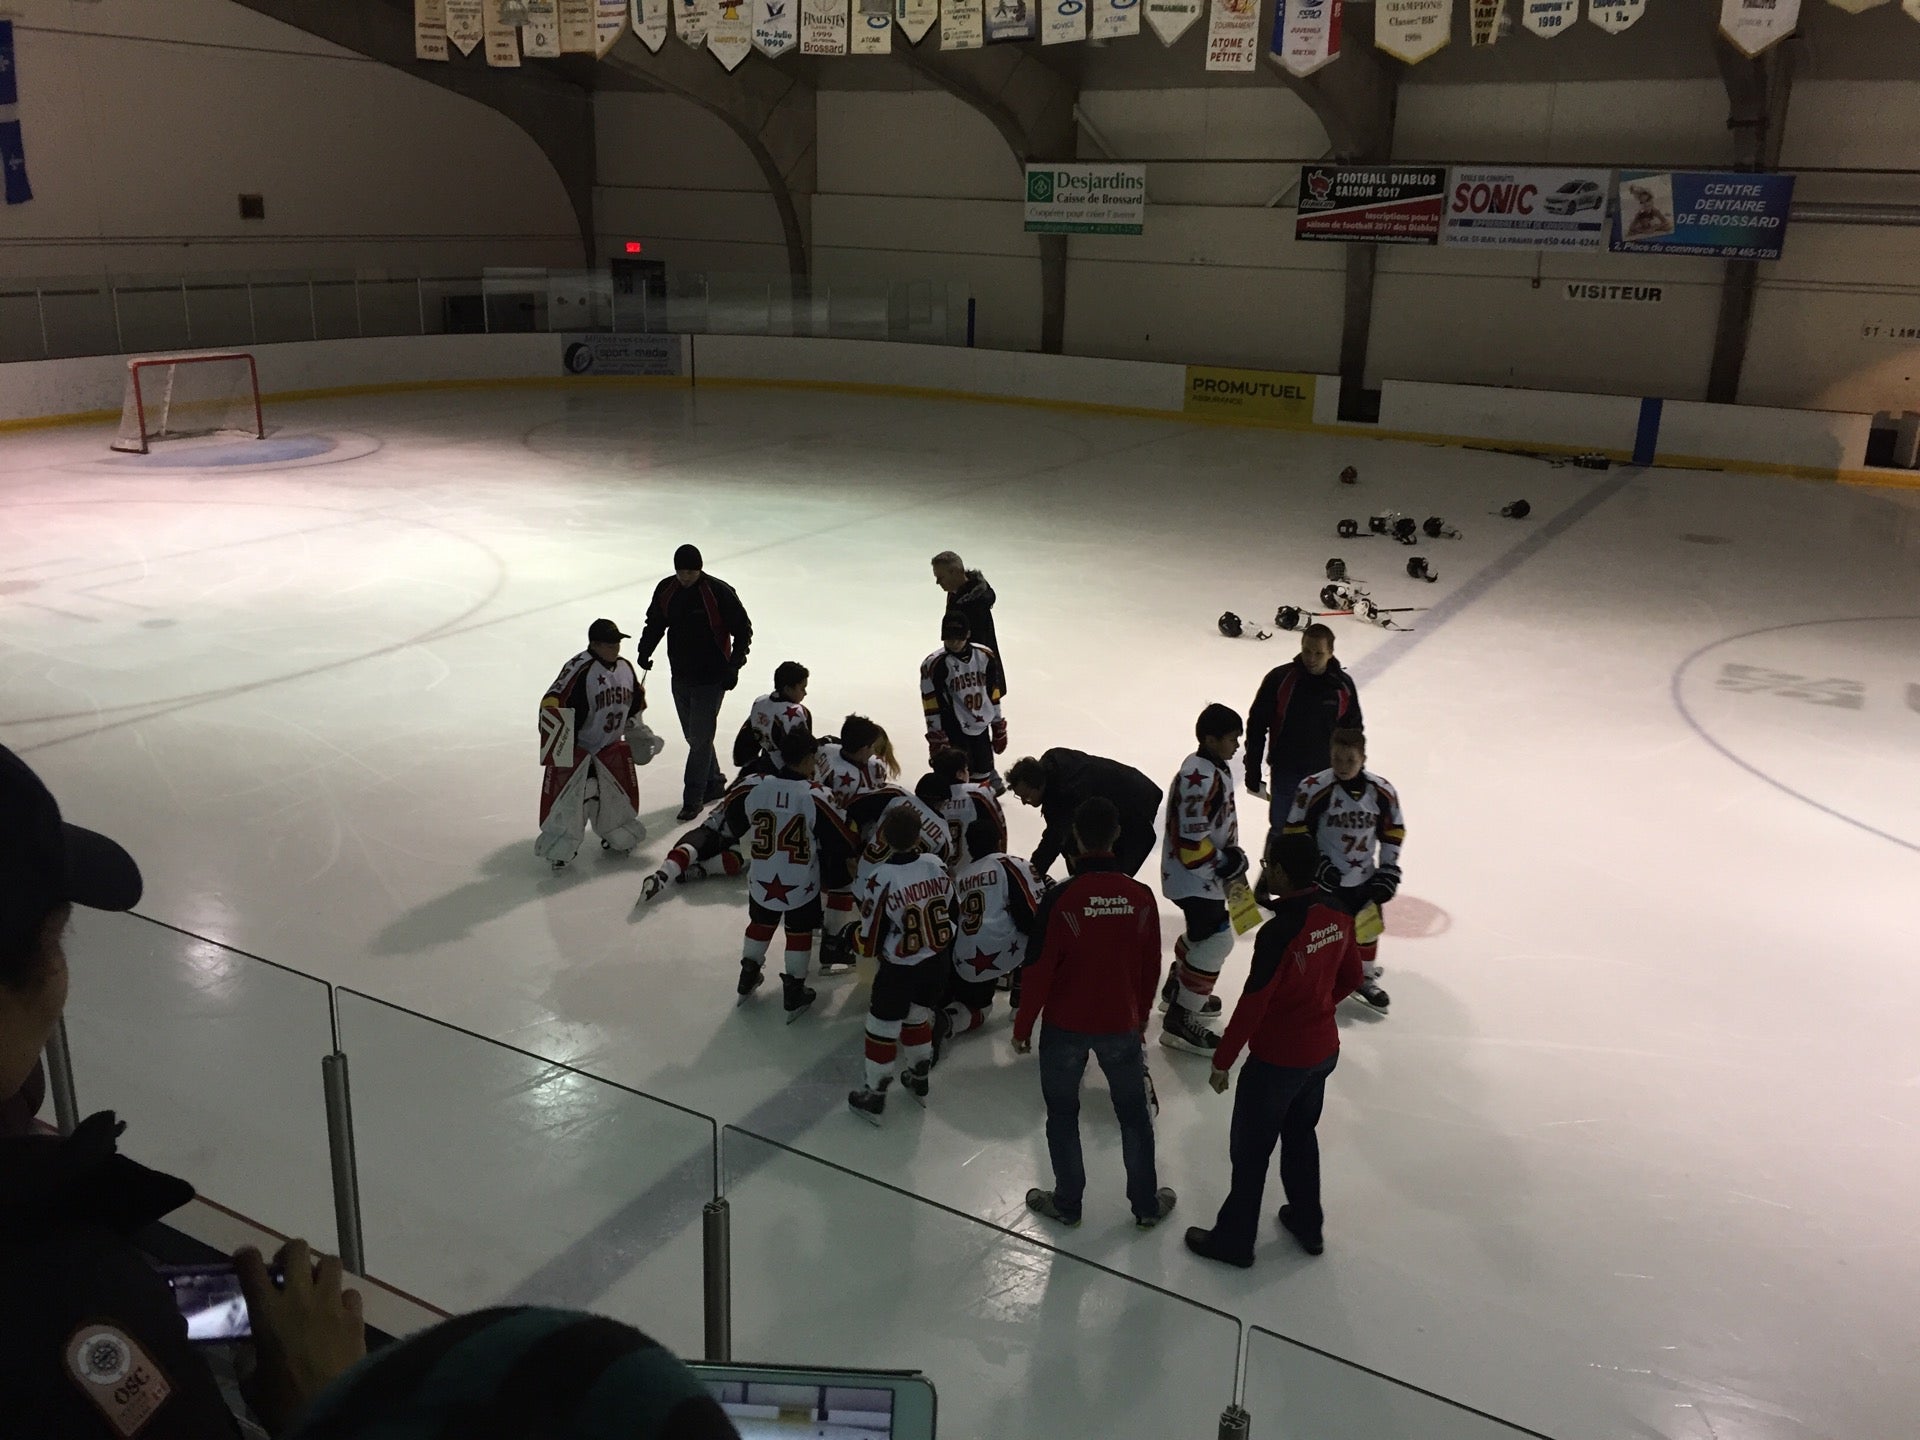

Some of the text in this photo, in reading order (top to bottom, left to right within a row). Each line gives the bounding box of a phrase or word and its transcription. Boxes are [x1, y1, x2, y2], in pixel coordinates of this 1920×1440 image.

[1538, 16, 1562, 27] 1998
[764, 39, 784, 47] 1999
[804, 42, 844, 54] Brossard
[1211, 38, 1242, 48] ATOME
[1210, 52, 1241, 62] PETITE
[1057, 172, 1143, 192] Desjardins
[1336, 172, 1437, 185] FOOTBALL DIABLOS
[1335, 185, 1400, 197] SAISON 2017
[1705, 183, 1762, 197] CENTRE
[1057, 193, 1142, 204] Caisse de Brossard
[1452, 183, 1538, 215] SONIC
[1694, 199, 1767, 212] DENTAIRE
[1365, 212, 1439, 222] Inscriptions pour la
[1676, 213, 1780, 228] DE BROSSARD
[1306, 220, 1437, 232] saison de football 2017 des Diablos
[1623, 242, 1649, 251] Place
[1651, 244, 1664, 252] du
[1664, 245, 1715, 254] commerce
[1568, 284, 1662, 301] VISITEUR
[1193, 378, 1306, 400] PROMUTUEL
[776, 792, 789, 809] LI
[751, 808, 811, 865] 34
[959, 870, 997, 893] AHMED
[1089, 895, 1128, 907] Physio
[961, 889, 985, 936] 9
[1084, 906, 1135, 917] Dynamik
[895, 896, 953, 958] 86
[1310, 923, 1339, 941] Physio
[1306, 931, 1344, 954] Dynamik
